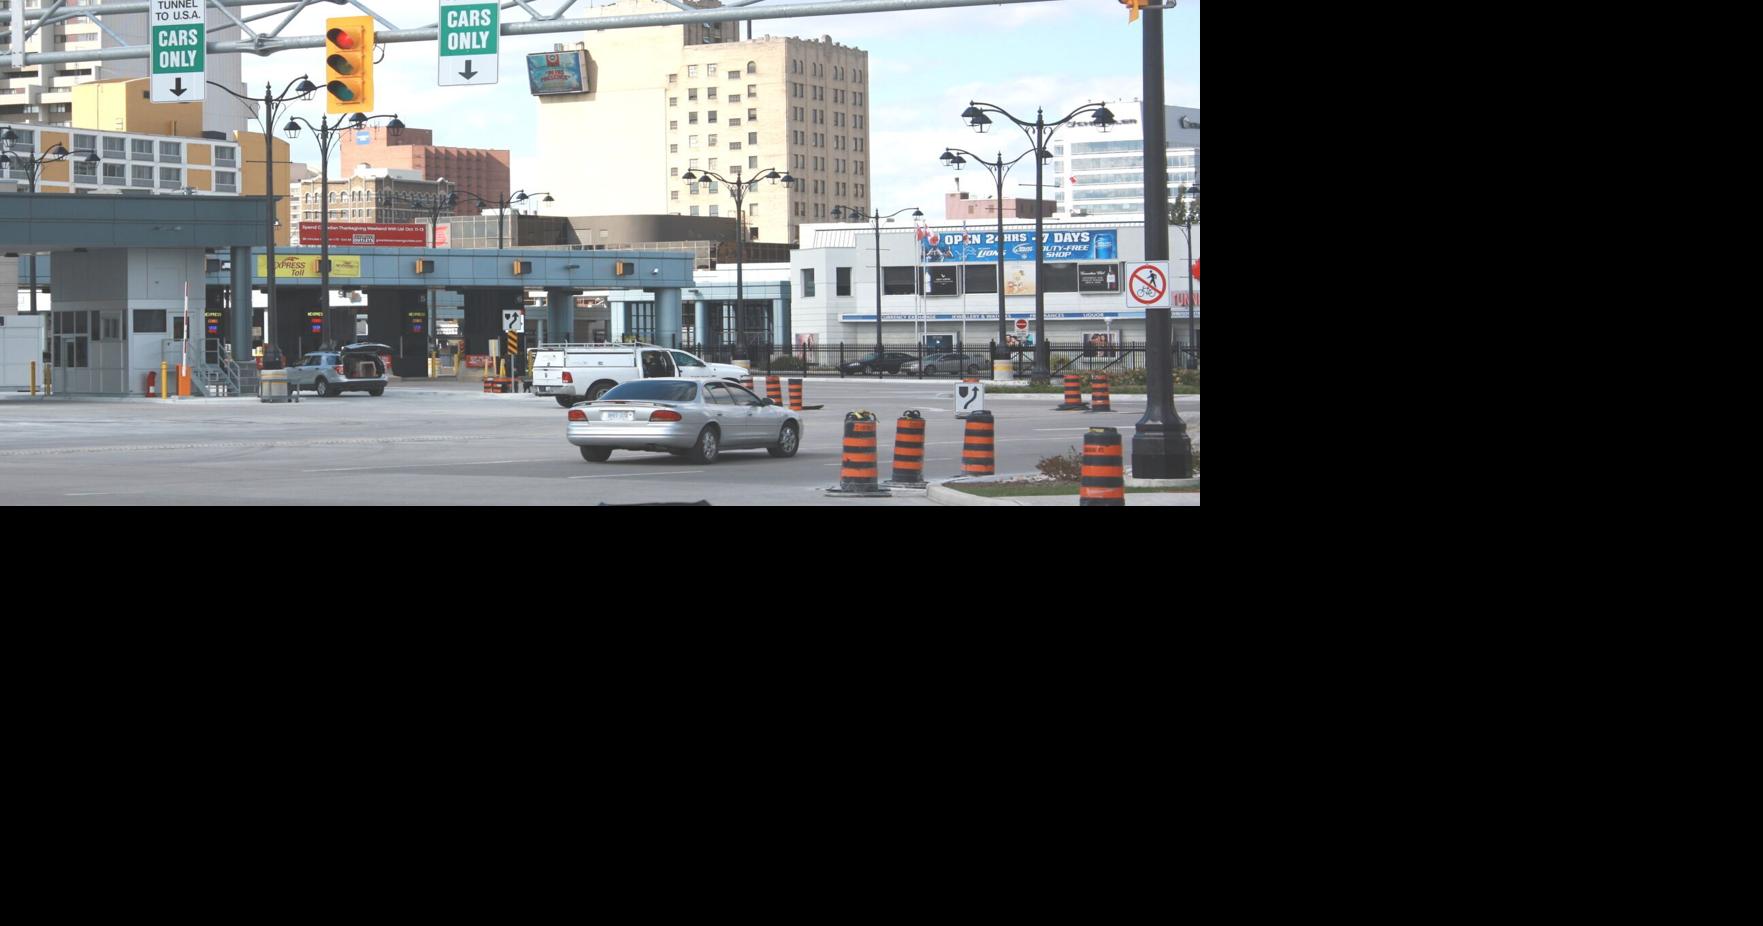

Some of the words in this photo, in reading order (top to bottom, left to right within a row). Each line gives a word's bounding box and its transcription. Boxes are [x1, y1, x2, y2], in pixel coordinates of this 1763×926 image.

[158, 0, 198, 9] TUNNEL
[156, 12, 169, 20] TO
[173, 11, 201, 20] U.S.A.
[447, 8, 491, 28] CARS
[158, 29, 198, 47] CARS
[447, 31, 490, 50] ONLY
[159, 50, 197, 68] ONLY
[1054, 232, 1090, 243] DAYS
[1042, 244, 1090, 252] UTY-FREE
[291, 269, 305, 277] Toll
